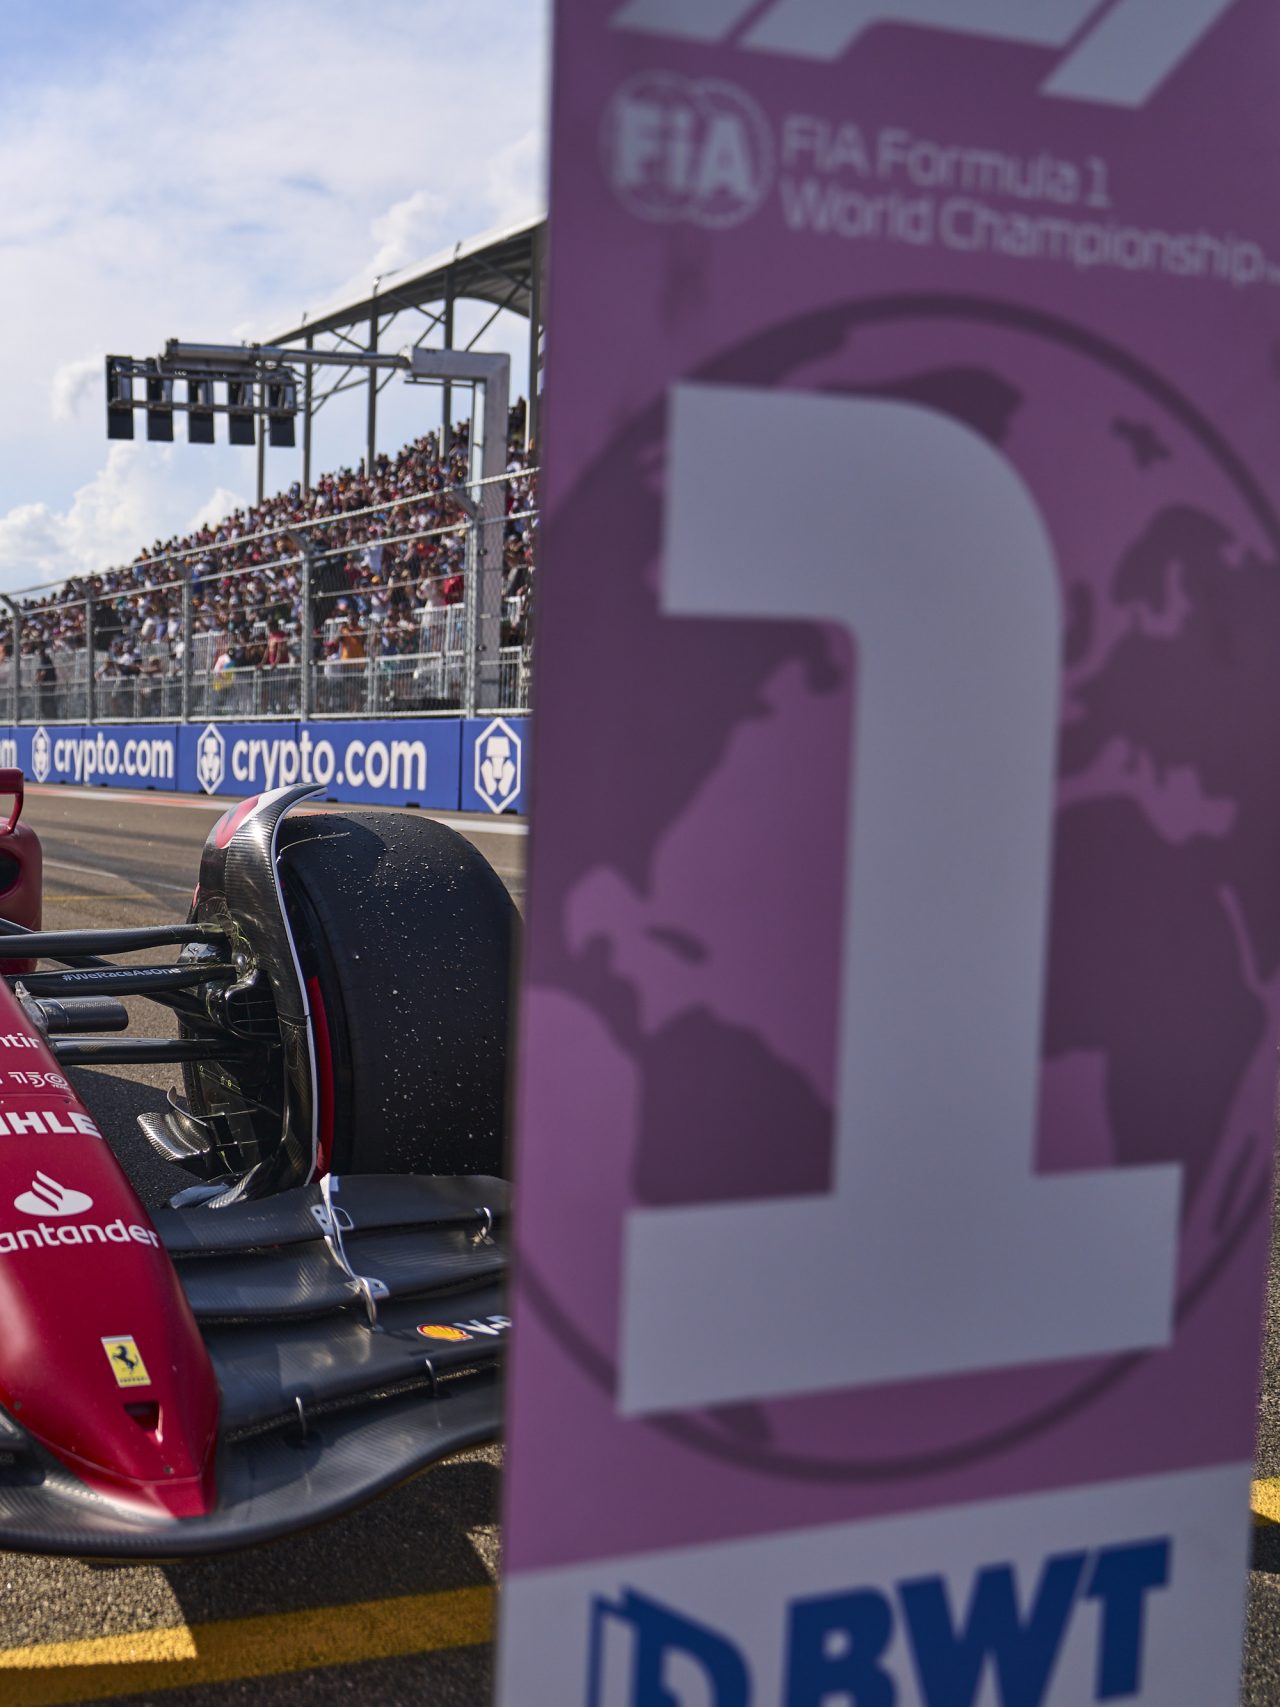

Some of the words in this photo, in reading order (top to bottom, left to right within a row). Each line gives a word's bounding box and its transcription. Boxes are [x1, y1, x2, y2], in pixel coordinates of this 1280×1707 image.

[781, 113, 869, 177] FIA
[876, 127, 1081, 204] Formula
[1085, 155, 1112, 208] 1
[778, 175, 933, 245] World
[54, 731, 175, 782] crypto.com
[231, 729, 428, 791] crypto.com
[617, 381, 1185, 1419] 1
[786, 1535, 1173, 1707] BWT
